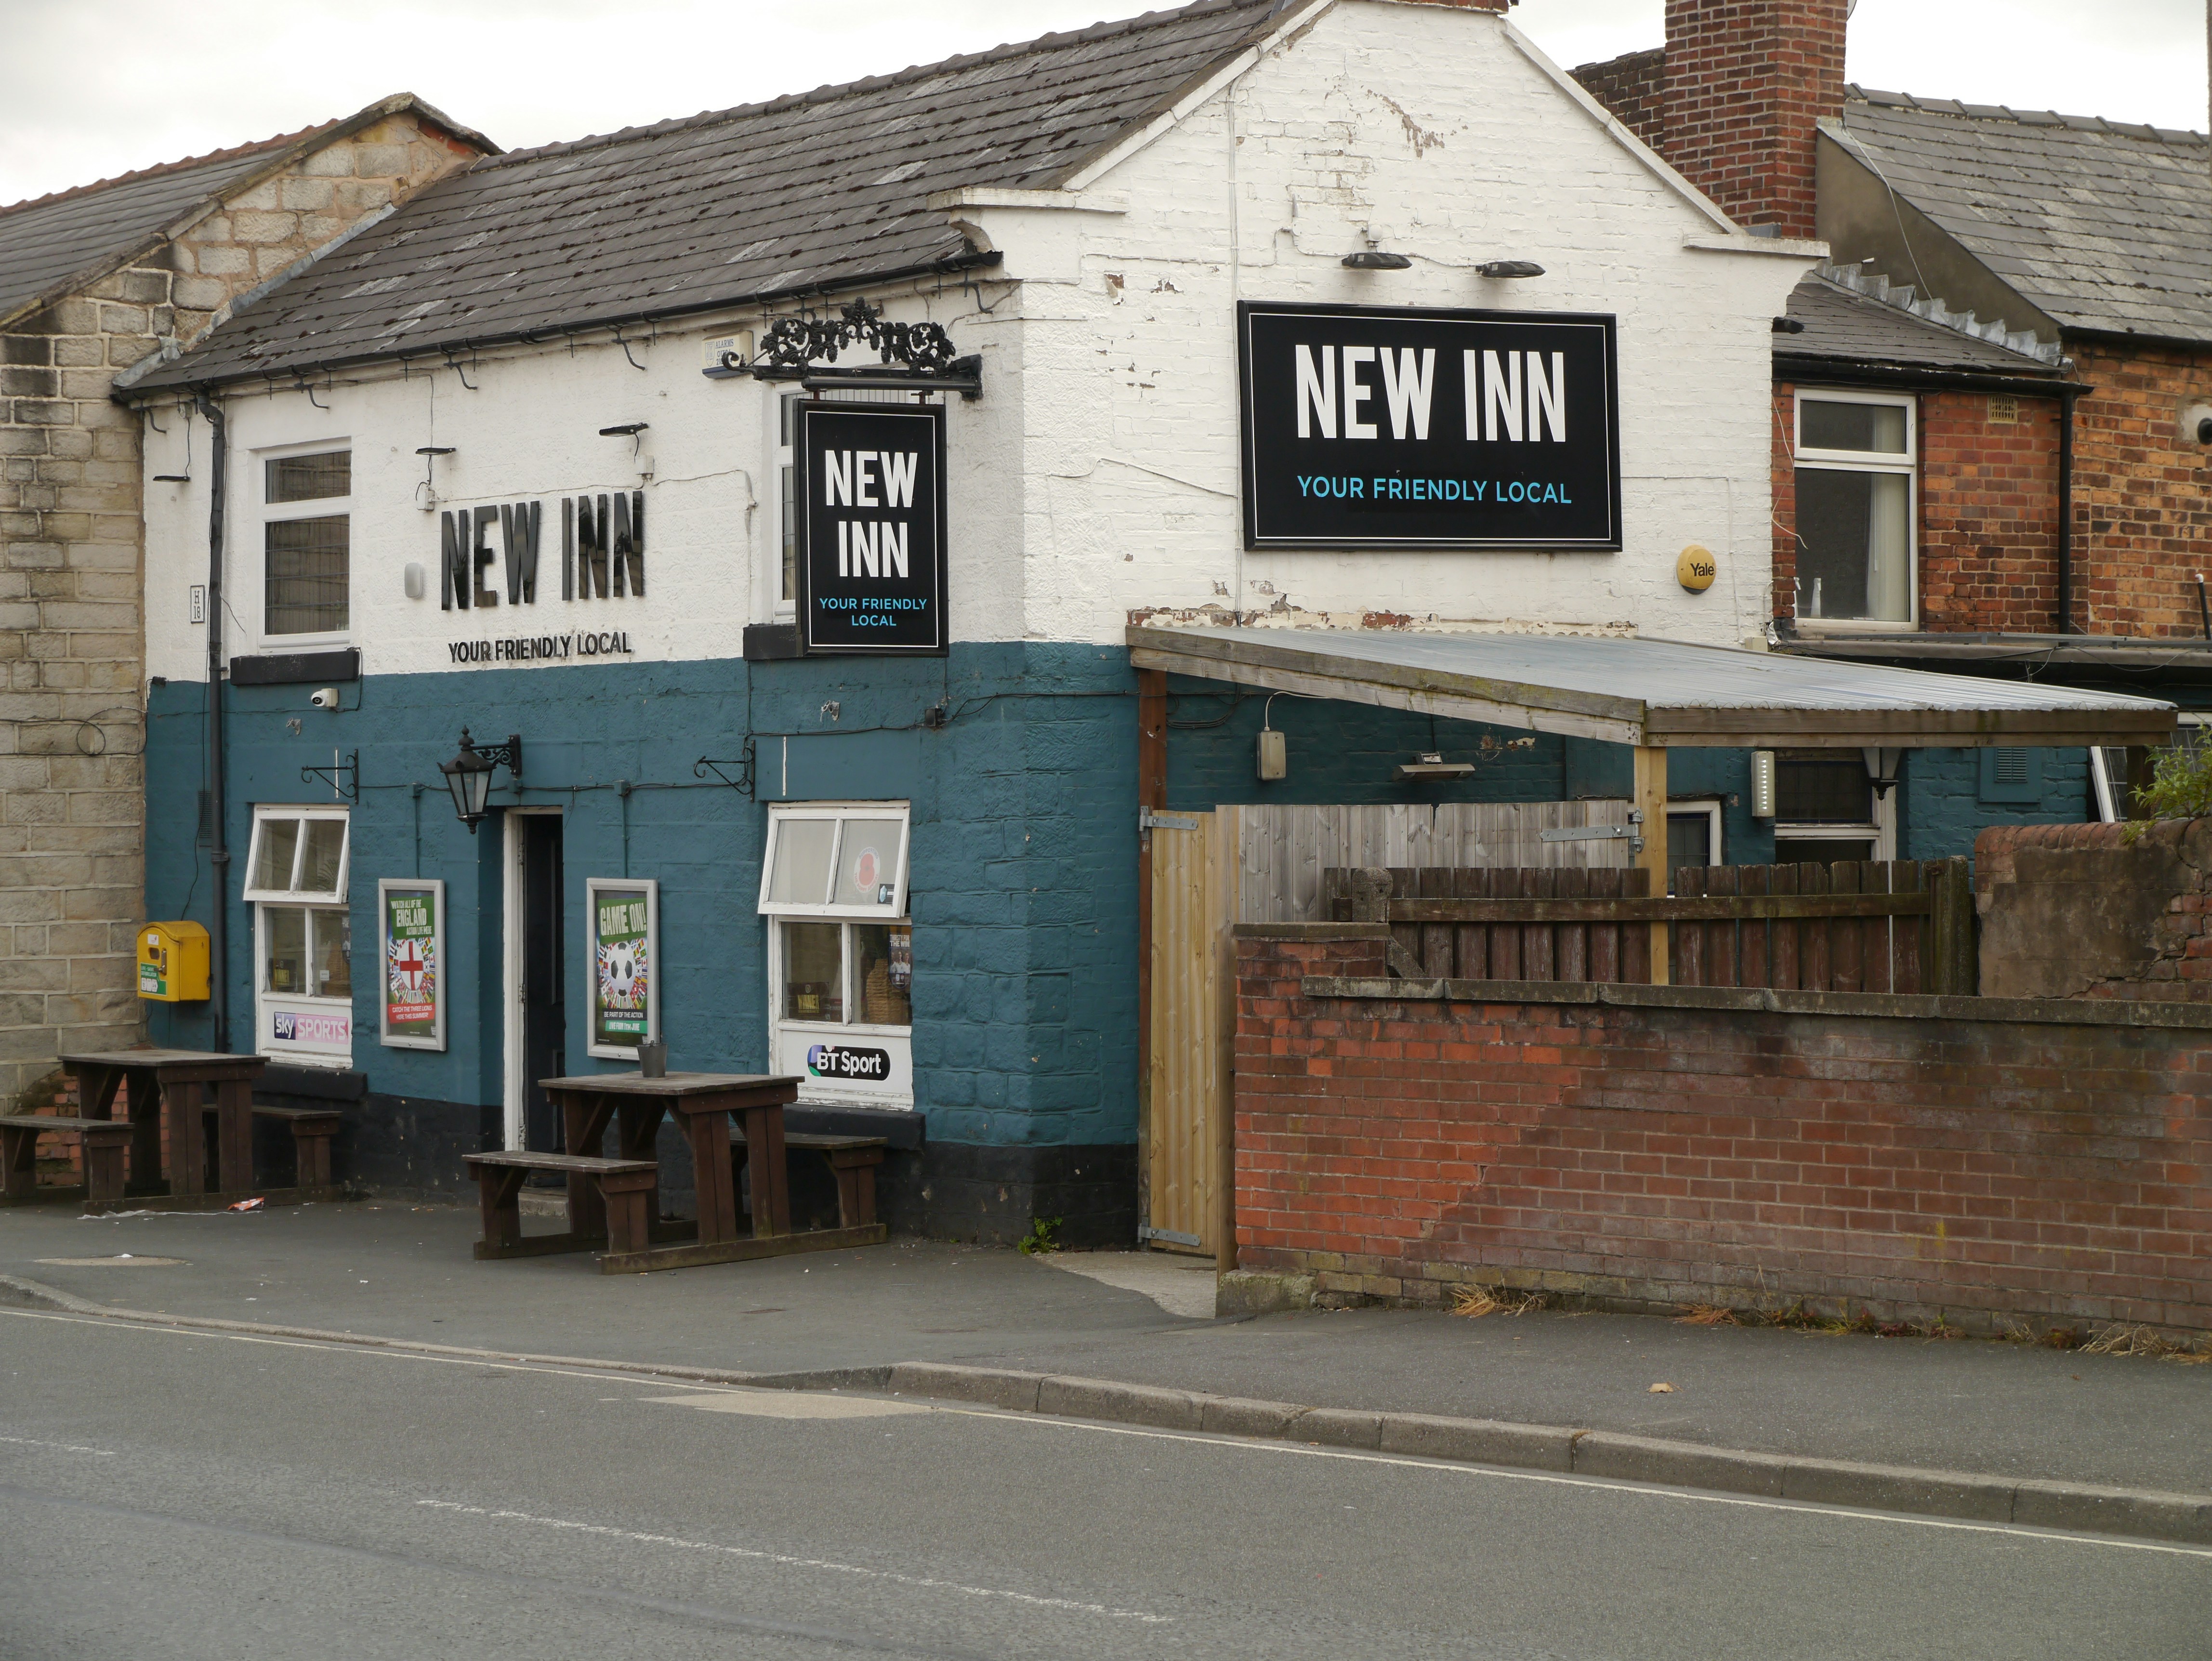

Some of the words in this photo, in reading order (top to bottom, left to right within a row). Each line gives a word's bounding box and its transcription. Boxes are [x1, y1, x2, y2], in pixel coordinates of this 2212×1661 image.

[715, 339, 734, 349] ALARMS
[1295, 344, 1435, 440] NEW
[1463, 349, 1566, 442] INN
[825, 450, 918, 508] NEW
[1297, 475, 1364, 499] YOUR
[1374, 477, 1487, 501] FRIENDLY
[1496, 481, 1572, 504] LOCAL
[441, 501, 540, 610] NEW
[562, 490, 643, 601] INN
[838, 521, 908, 578] INN
[1690, 563, 1714, 576] Yale
[195, 591, 200, 603] H
[819, 597, 857, 609] YOUR
[862, 598, 927, 610] FRIENDLY
[194, 606, 200, 619] 18
[852, 615, 896, 626] LOCAL
[448, 640, 491, 663] YOUR
[495, 635, 571, 661] FRIENDLY
[578, 632, 632, 656] LOCAL
[411, 899, 416, 908] OF
[396, 908, 427, 927] ENGLAND
[600, 905, 629, 936] GAME
[629, 902, 646, 932] ON!
[276, 1014, 294, 1039] sky
[298, 1017, 346, 1041] SPORTS
[817, 1052, 839, 1070] BT
[841, 1051, 881, 1076] Sport
